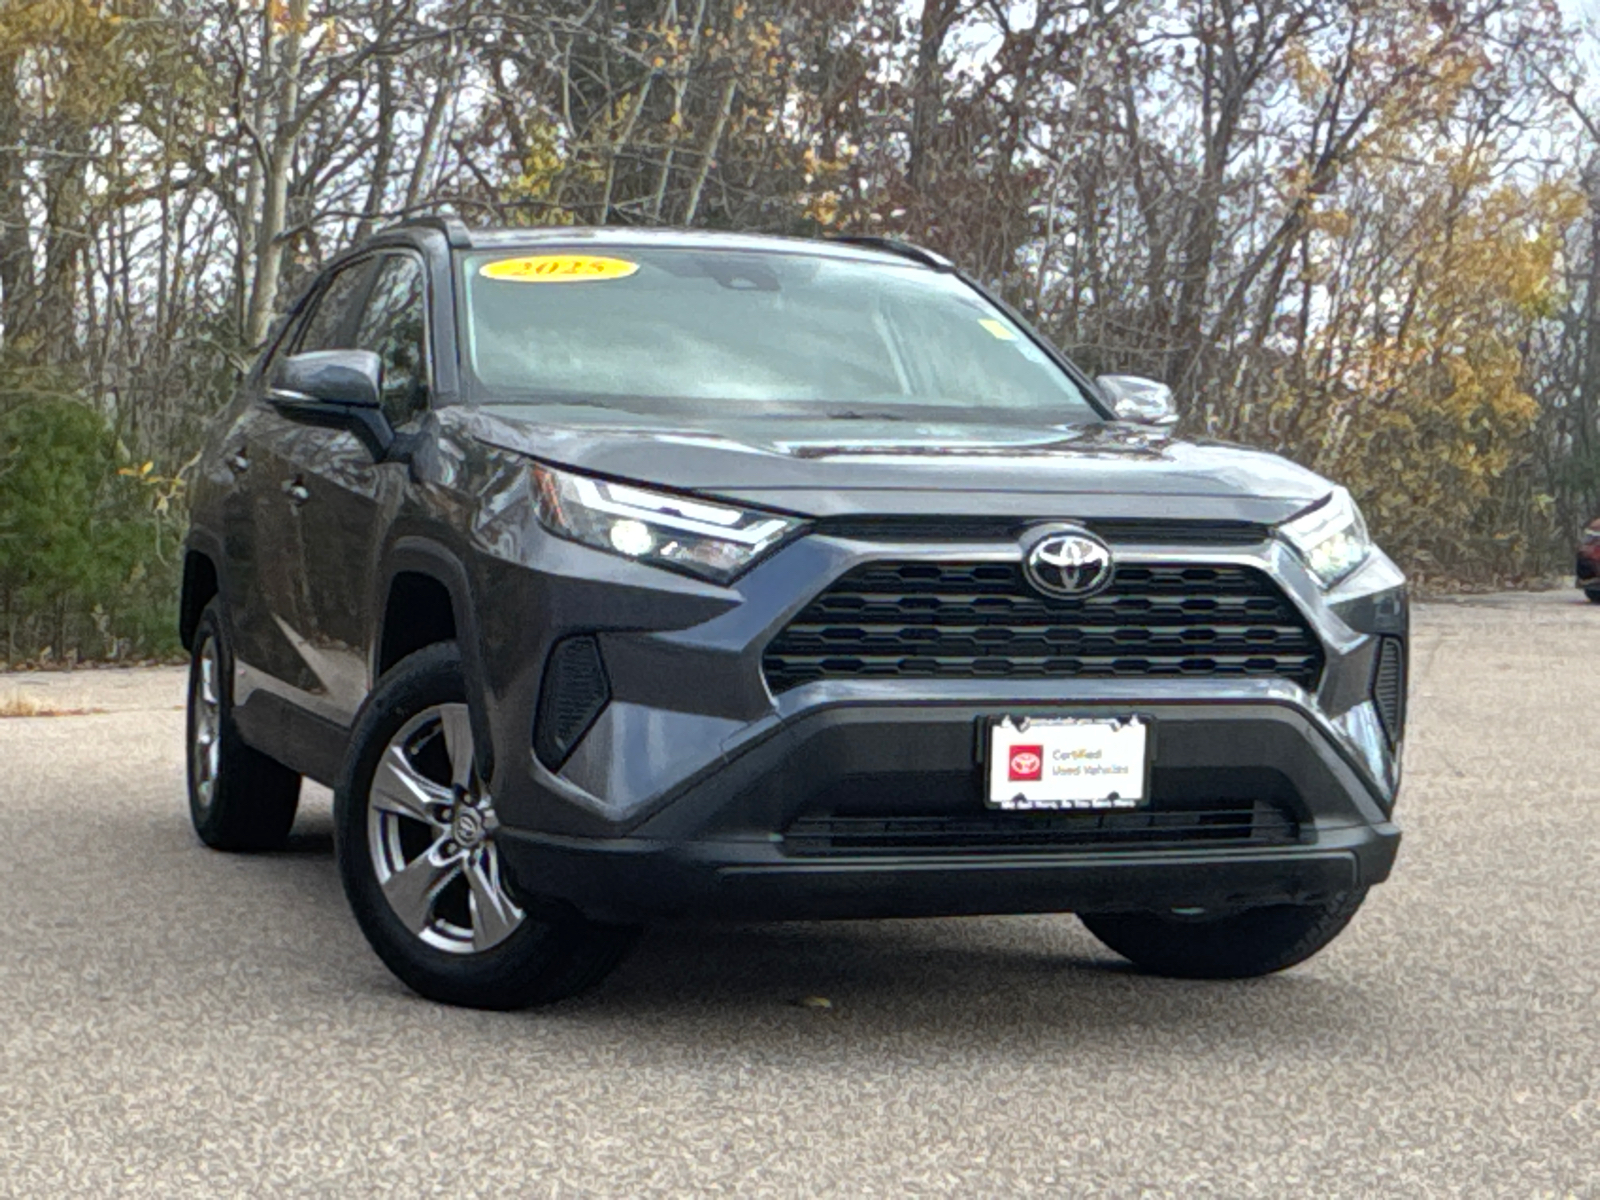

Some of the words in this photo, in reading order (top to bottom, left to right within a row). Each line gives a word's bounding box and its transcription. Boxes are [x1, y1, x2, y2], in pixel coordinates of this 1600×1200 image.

[509, 261, 605, 276] 2025
[1052, 749, 1102, 760] Certified
[1052, 765, 1081, 775] Used
